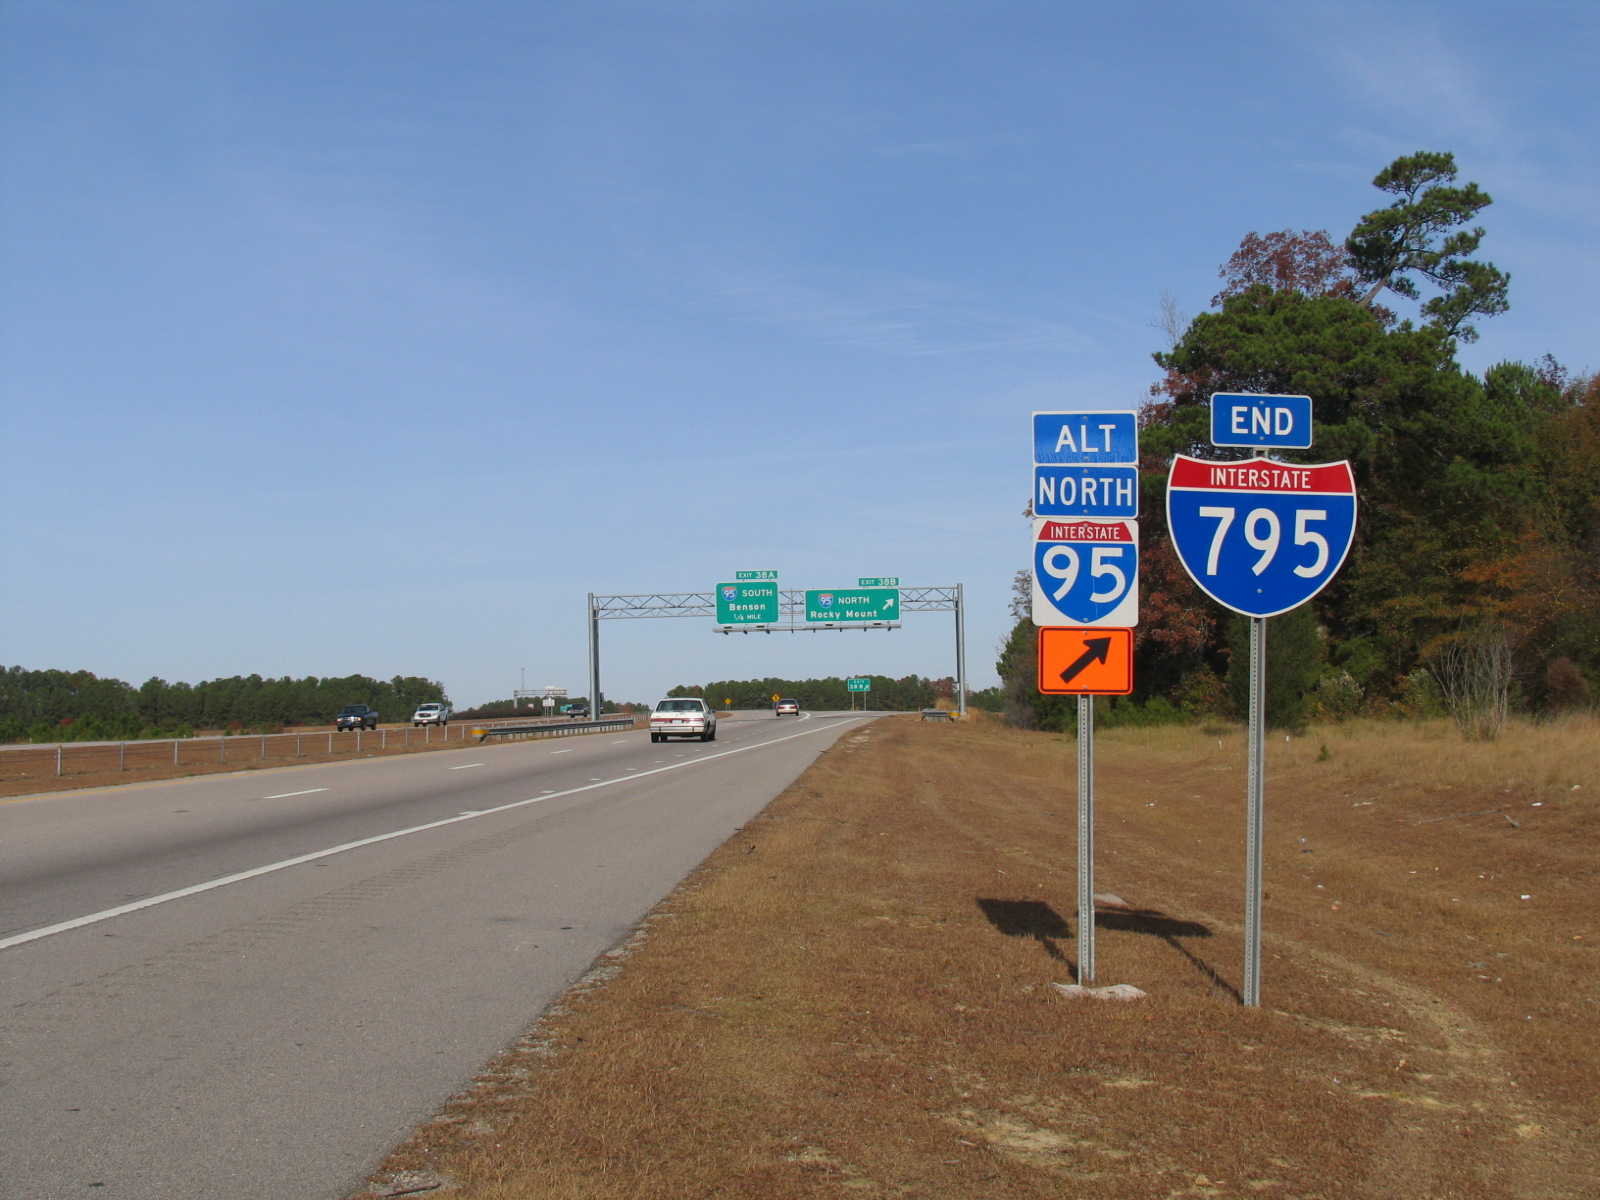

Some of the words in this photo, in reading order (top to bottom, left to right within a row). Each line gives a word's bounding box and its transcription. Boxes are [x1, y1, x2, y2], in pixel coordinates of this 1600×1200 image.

[1231, 406, 1293, 435] END
[1054, 424, 1116, 453] ALT
[1210, 467, 1311, 489] INTERSTATE
[1038, 476, 1133, 506] NORTH
[1050, 526, 1121, 540] INTERSTATE
[1199, 506, 1330, 579] 795
[756, 571, 775, 579] 38A
[1042, 545, 1126, 604] 95
[878, 578, 896, 586] 38B
[723, 589, 735, 598] 95
[742, 589, 773, 597] SOUTH
[820, 597, 831, 605] 95
[838, 596, 870, 604] NORTH
[729, 603, 766, 611] Benson
[810, 610, 841, 620] Rocky
[846, 610, 878, 618] Mount
